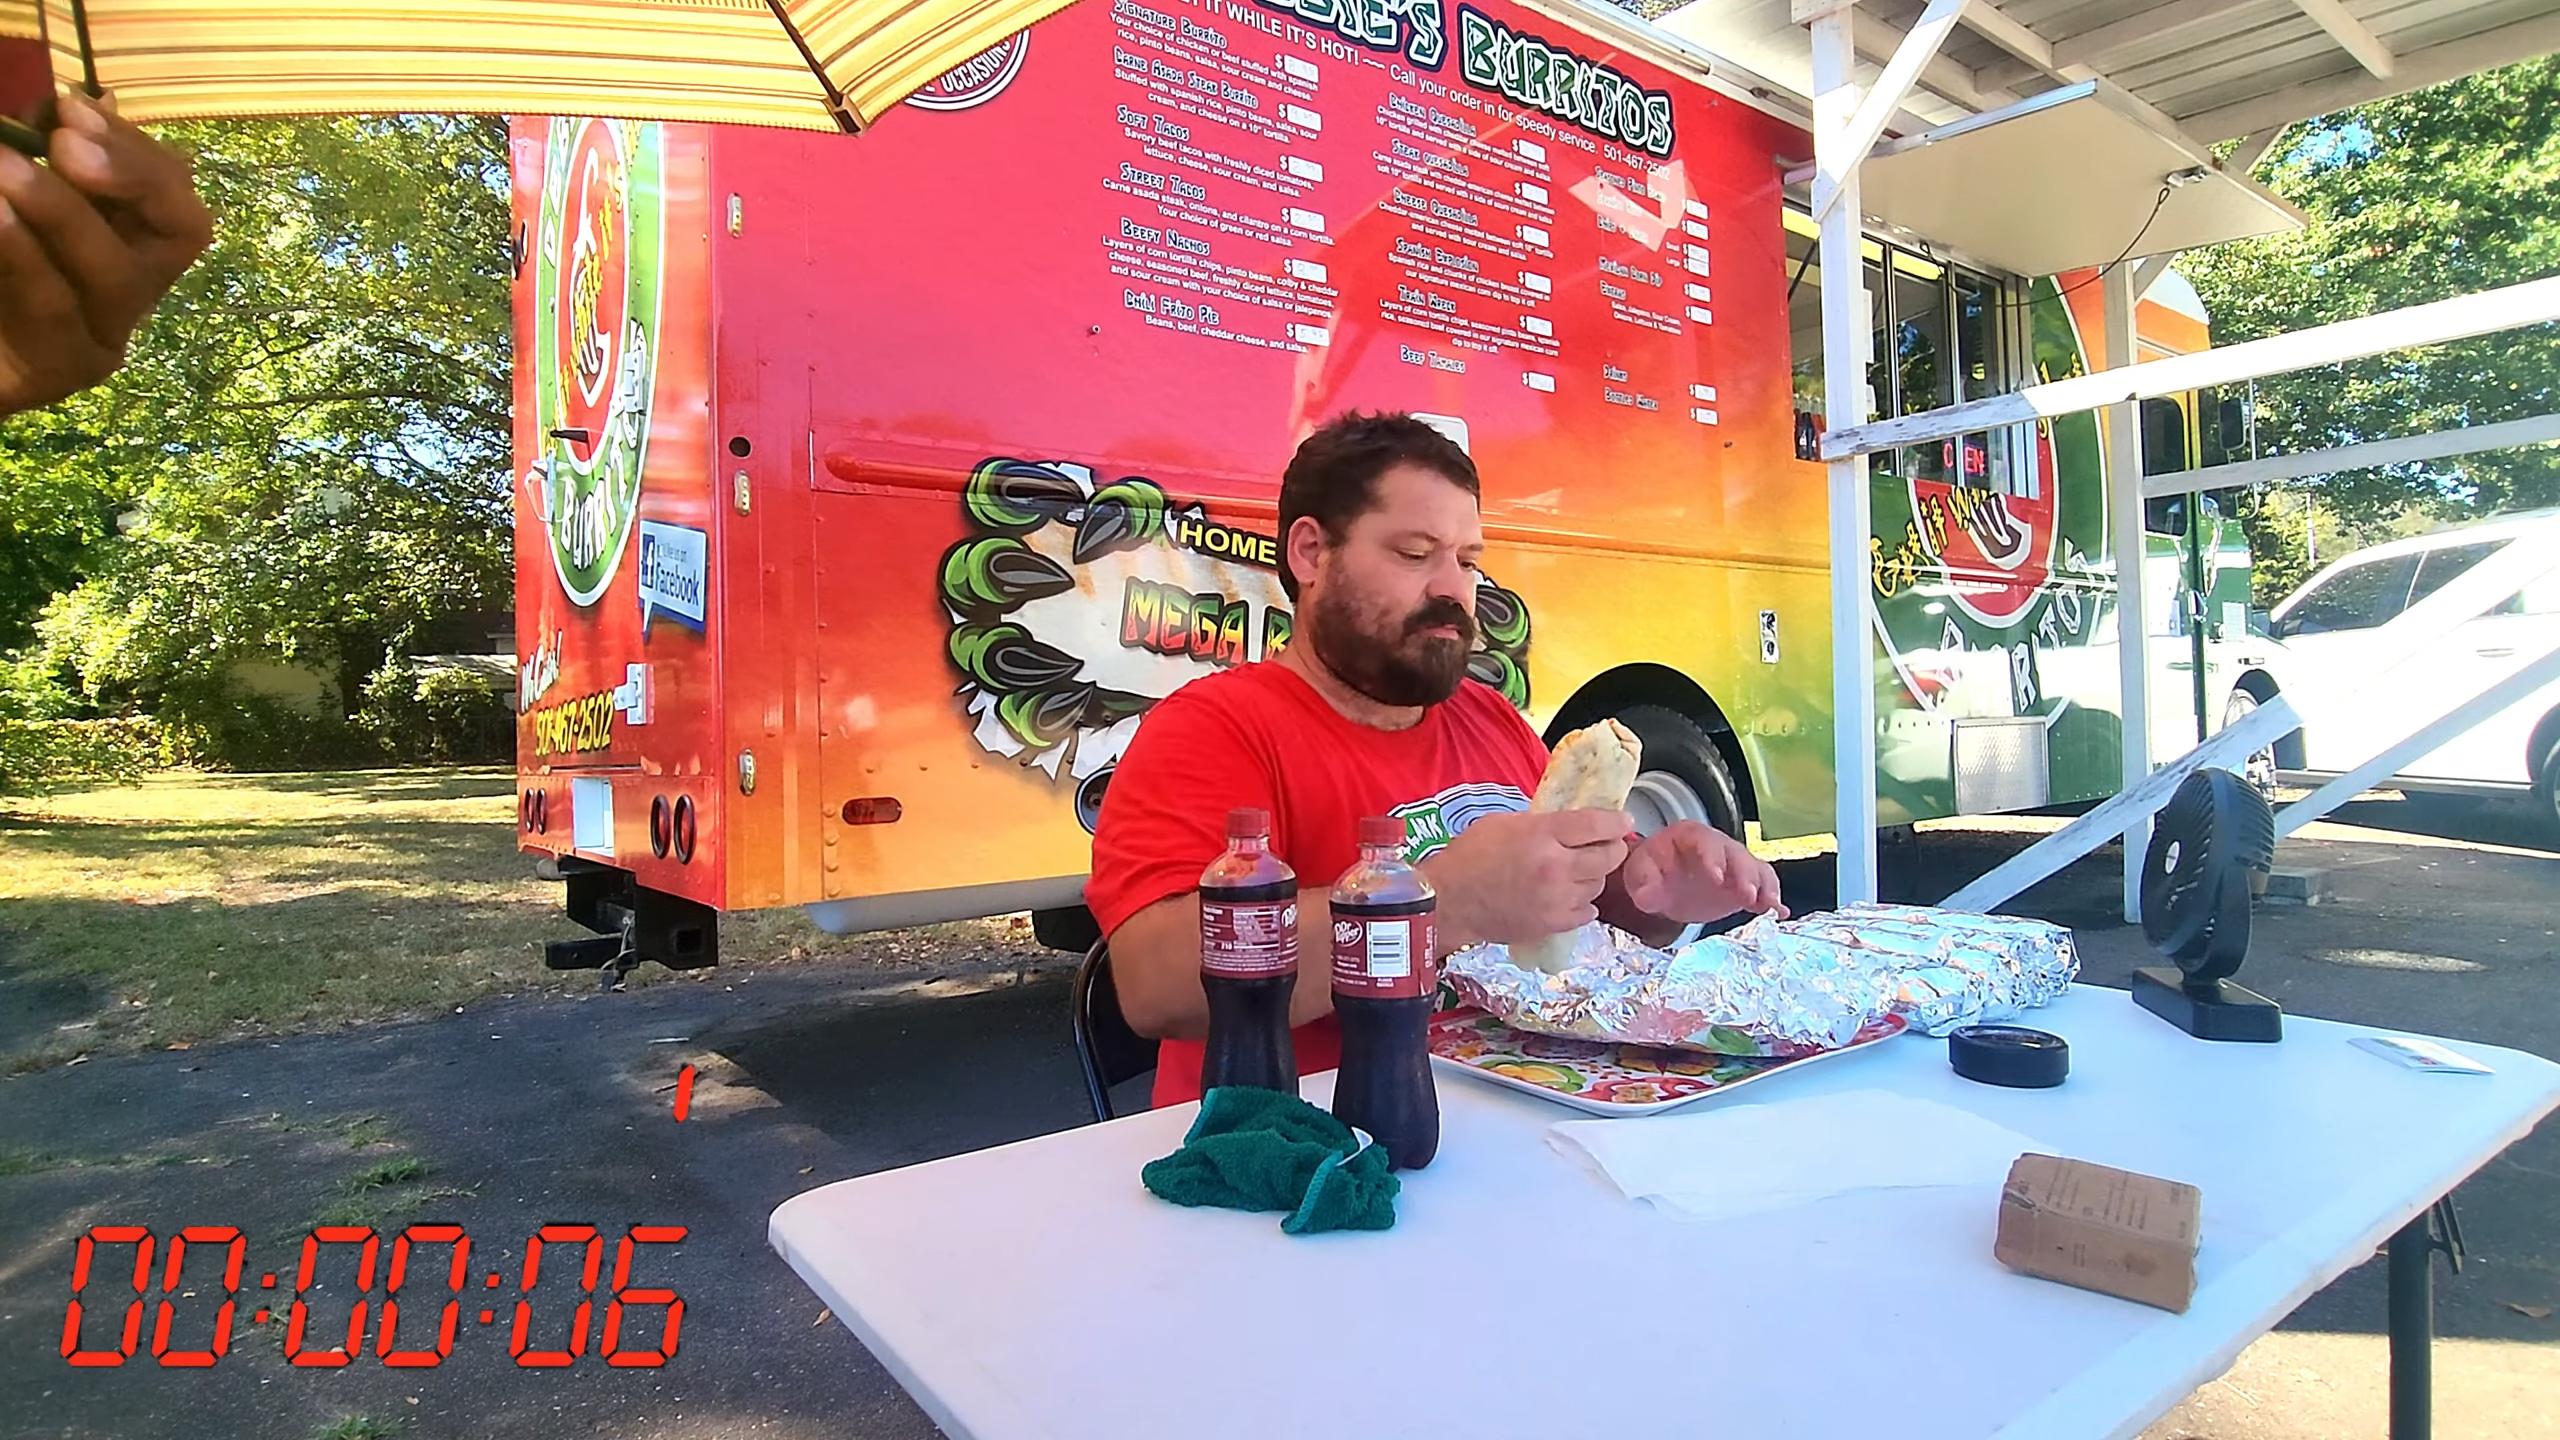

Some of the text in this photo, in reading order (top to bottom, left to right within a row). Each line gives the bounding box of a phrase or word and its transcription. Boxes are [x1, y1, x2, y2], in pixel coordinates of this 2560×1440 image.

[1226, 1, 1282, 37] WHILE
[1286, 23, 1317, 50] IT'S
[1320, 36, 1359, 66] HOT!
[1390, 64, 1416, 87] Call
[1418, 77, 1447, 97] your
[1449, 88, 1481, 112] order
[1484, 100, 1496, 116] in
[1498, 105, 1515, 123] for
[1515, 115, 1557, 141] speedy
[1558, 129, 1598, 155] service.
[1603, 145, 1671, 181] 501-467-2502
[1461, 9, 1674, 155] BURRITOS
[1943, 442, 1985, 476] OEN
[1179, 520, 1278, 566] HOME
[655, 561, 700, 607] Facebook
[1125, 581, 1246, 665] MEGA
[535, 690, 614, 757] 501-467-2502
